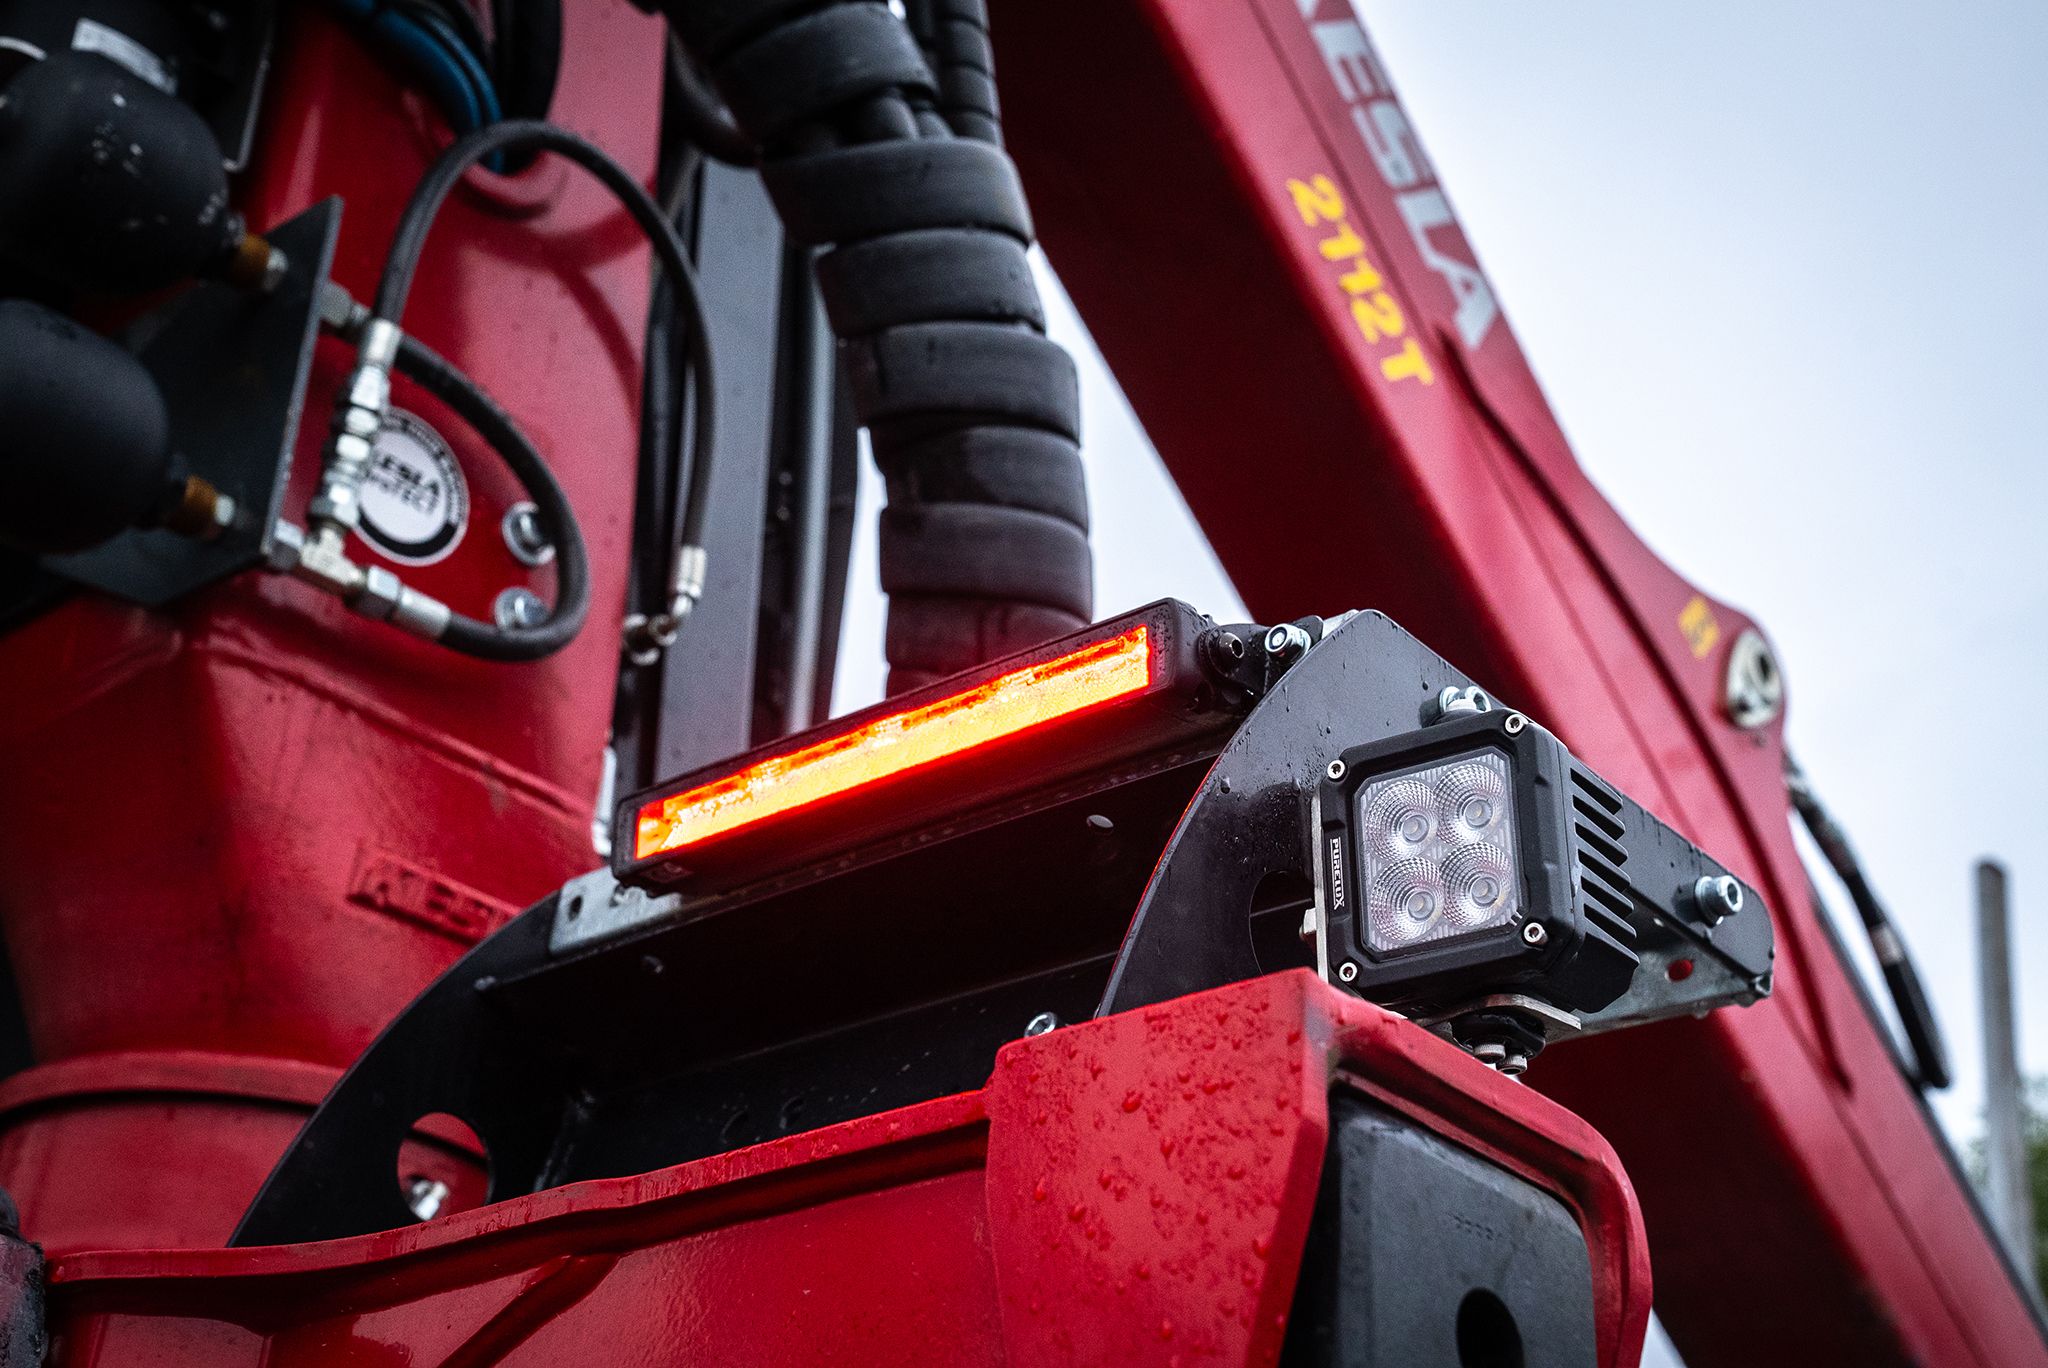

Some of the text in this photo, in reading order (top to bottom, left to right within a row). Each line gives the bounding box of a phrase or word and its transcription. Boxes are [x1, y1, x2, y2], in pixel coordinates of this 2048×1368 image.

[1286, 174, 1434, 386] 2112T
[1295, 0, 1500, 351] ESLA
[1329, 836, 1345, 910] PURELUX
